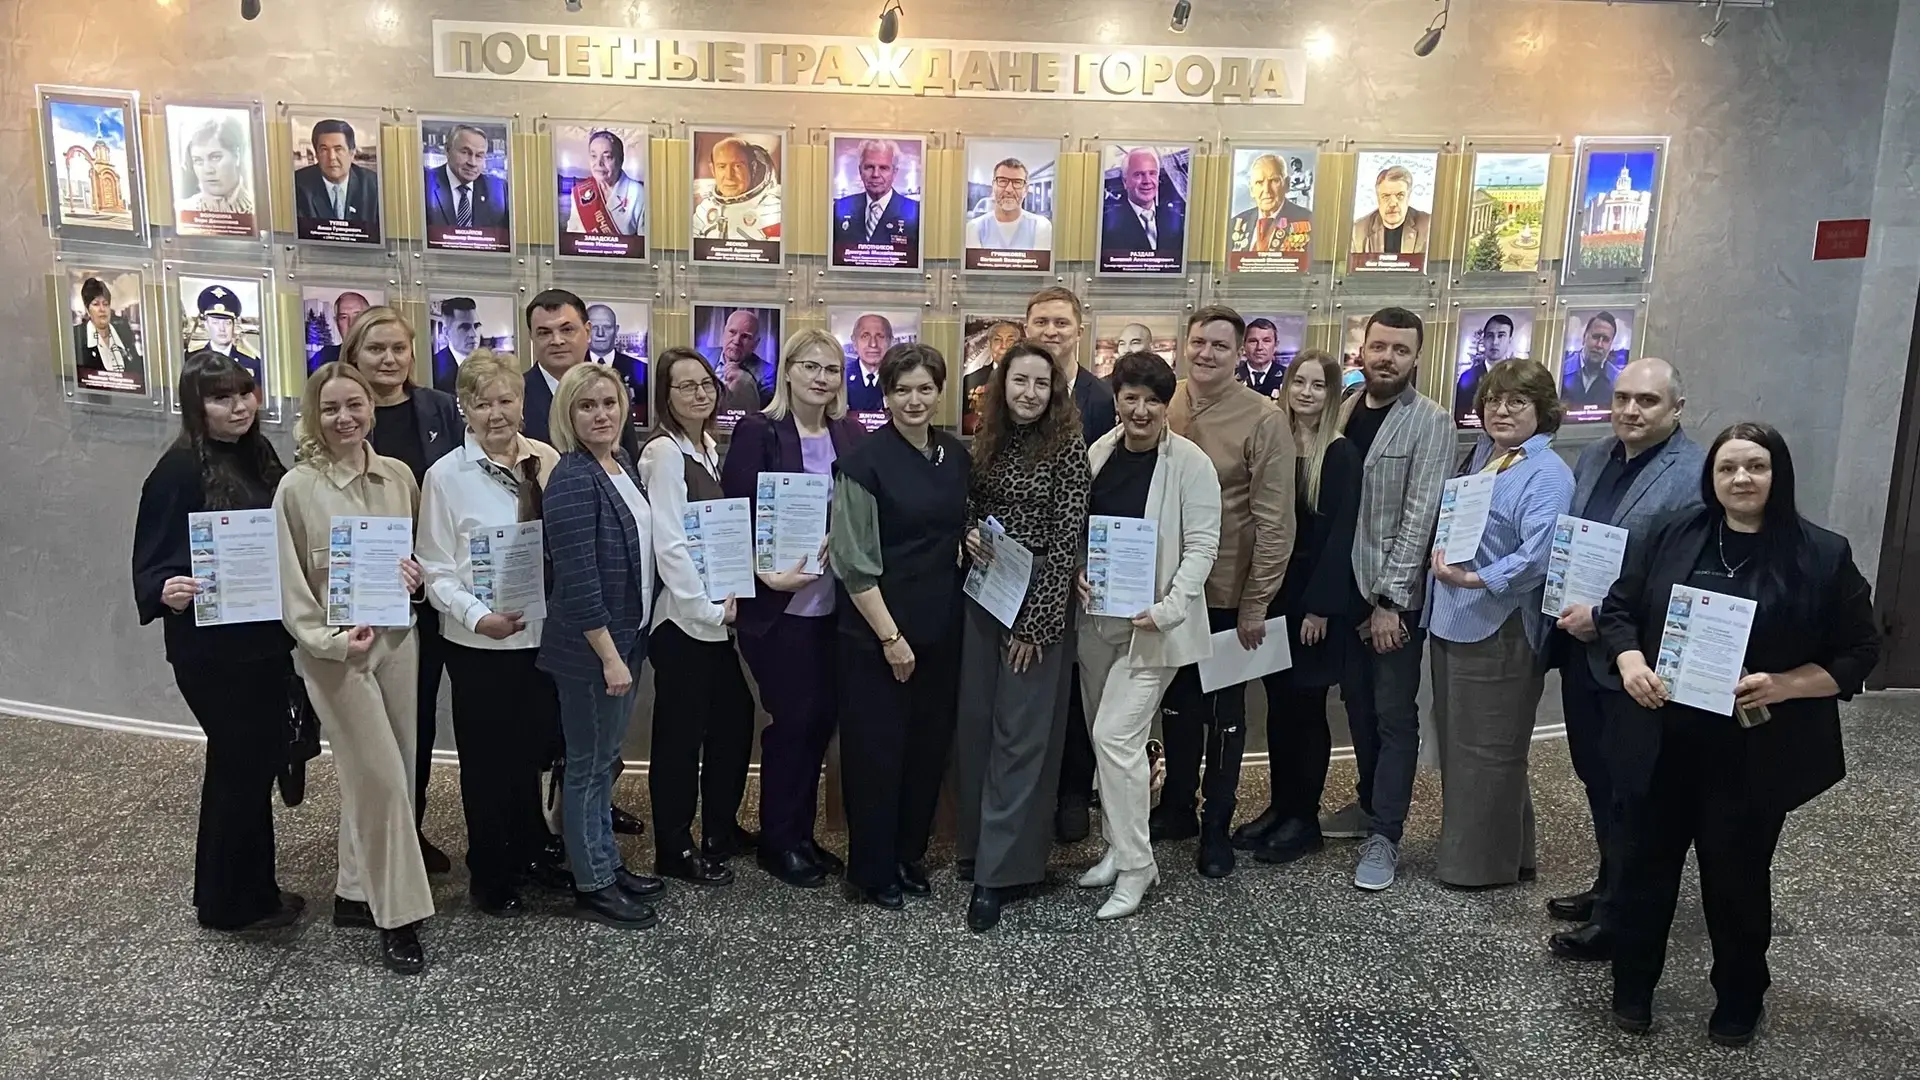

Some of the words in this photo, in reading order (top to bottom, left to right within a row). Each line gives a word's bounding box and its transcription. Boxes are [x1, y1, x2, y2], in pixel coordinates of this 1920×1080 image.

[443, 31, 746, 83] ПОЧЕТНЫЕ
[755, 43, 1062, 98] ГРАЖДАНЕ
[1073, 53, 1292, 105] ГОРОДА
